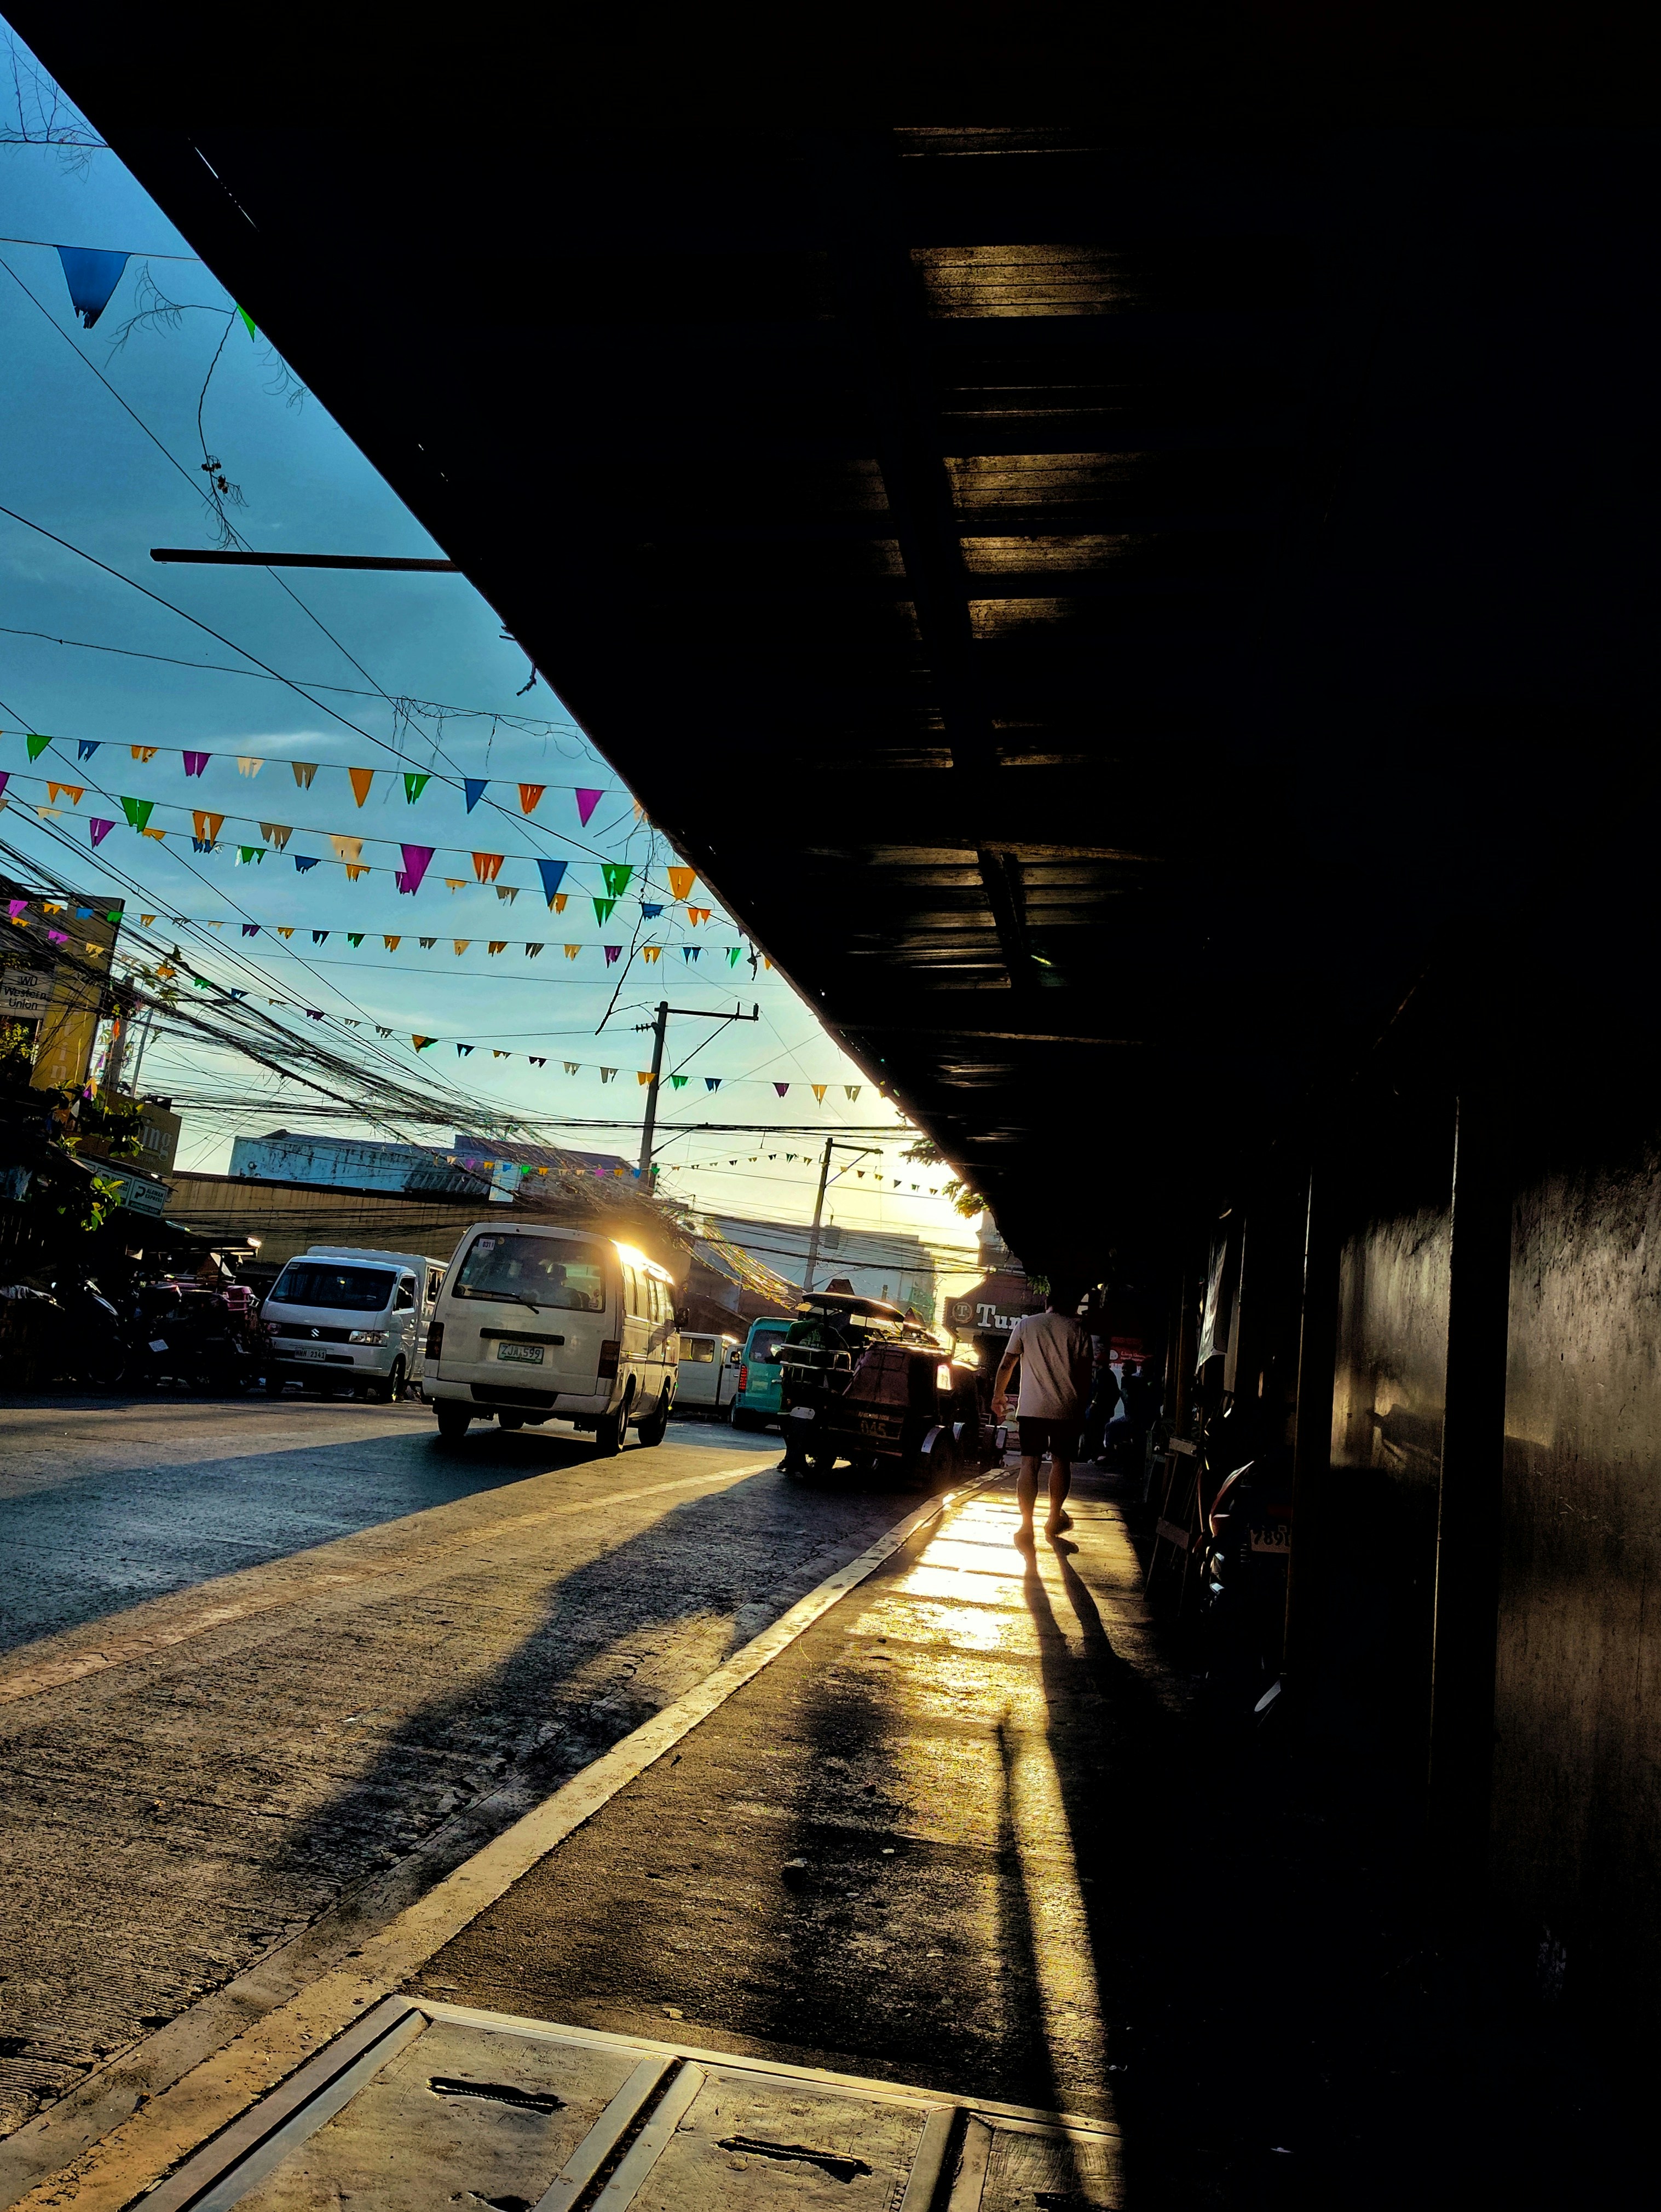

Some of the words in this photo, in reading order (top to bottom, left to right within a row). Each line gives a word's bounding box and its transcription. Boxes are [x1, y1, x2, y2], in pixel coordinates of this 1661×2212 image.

[4, 986, 47, 1000] Western
[9, 997, 38, 1010] Union
[145, 1194, 163, 1203] EXPRESS
[523, 1348, 540, 1359] 599
